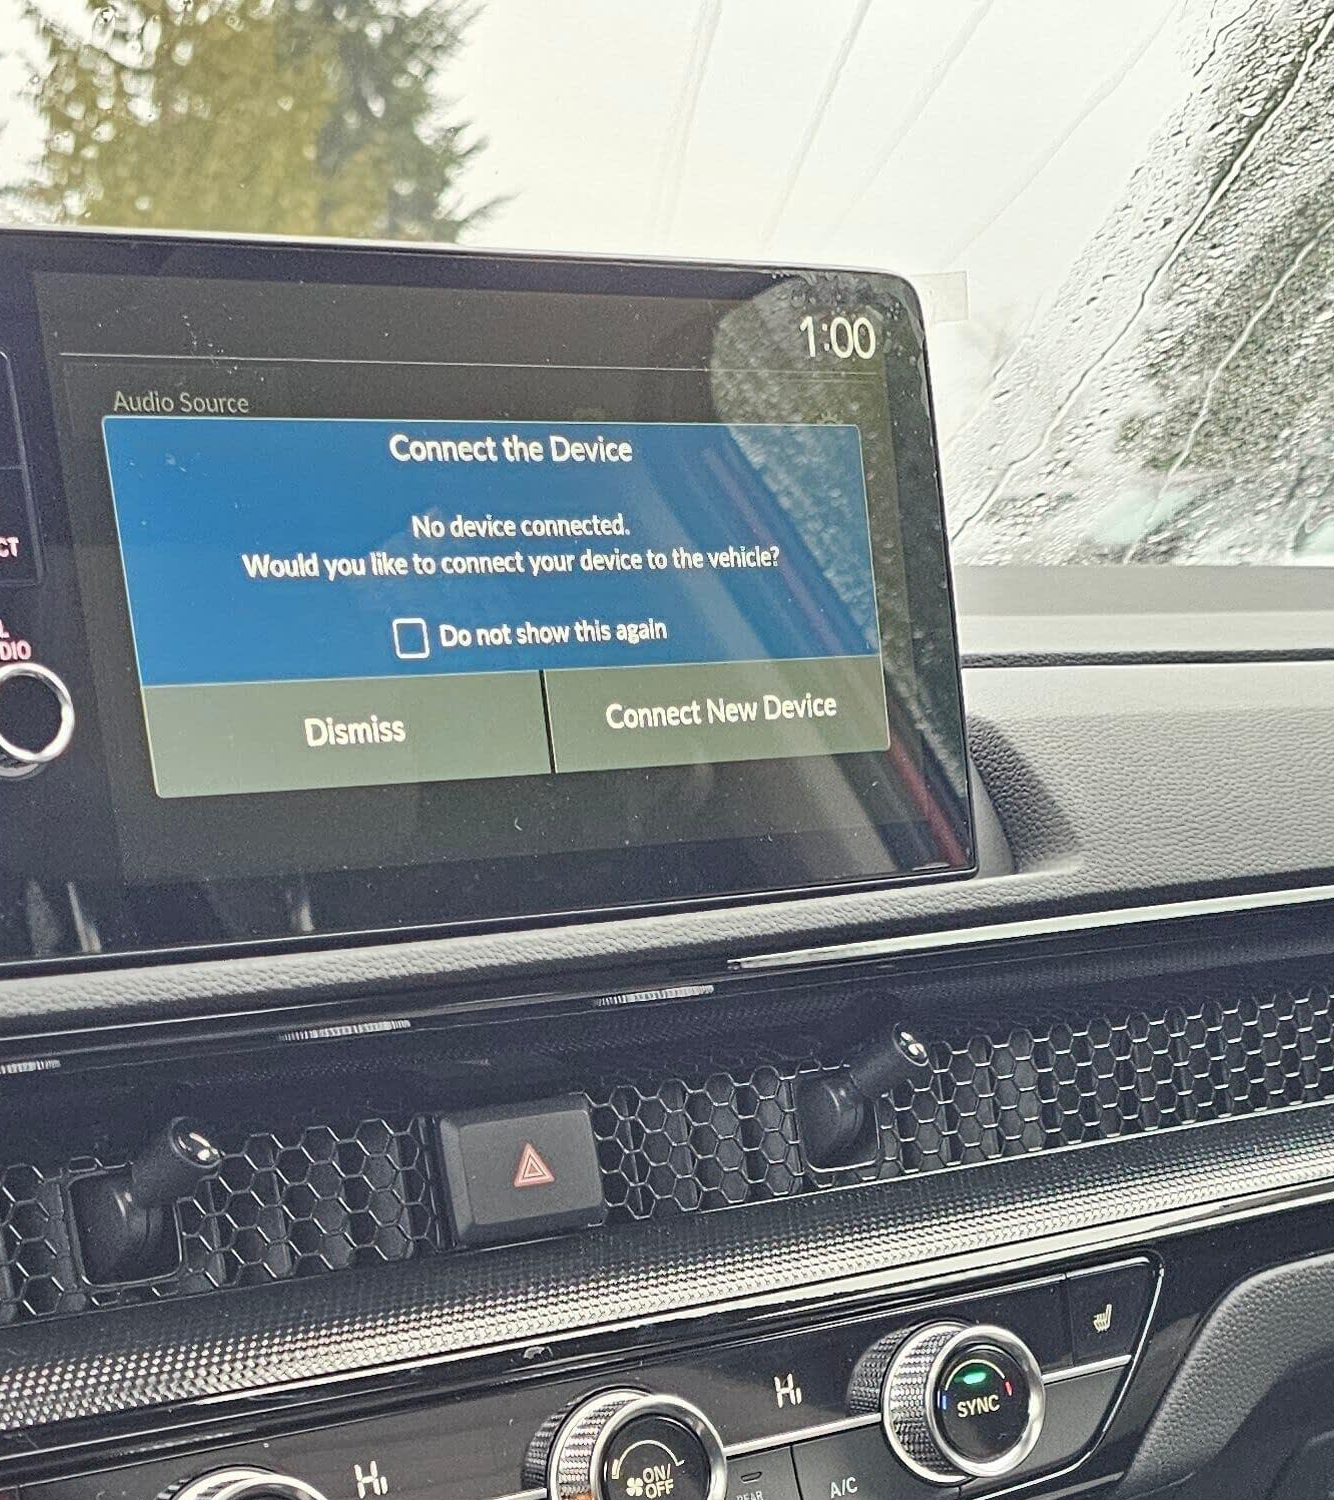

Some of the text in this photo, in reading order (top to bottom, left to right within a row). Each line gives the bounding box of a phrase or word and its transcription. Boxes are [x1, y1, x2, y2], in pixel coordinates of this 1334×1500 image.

[798, 315, 876, 360] 1:00
[113, 391, 249, 415] Audio Source
[389, 435, 633, 464] Connect the Device
[411, 513, 631, 538] No device connected.
[242, 545, 780, 581] Would you like to connect your device to the vehicle?
[439, 619, 668, 648] Do not show this again
[604, 692, 838, 731] Connect New Device
[304, 715, 407, 747] Dismiss
[955, 1393, 1001, 1420] SYNC
[644, 1479, 675, 1500] OFF
[830, 1475, 858, 1500] A/C
